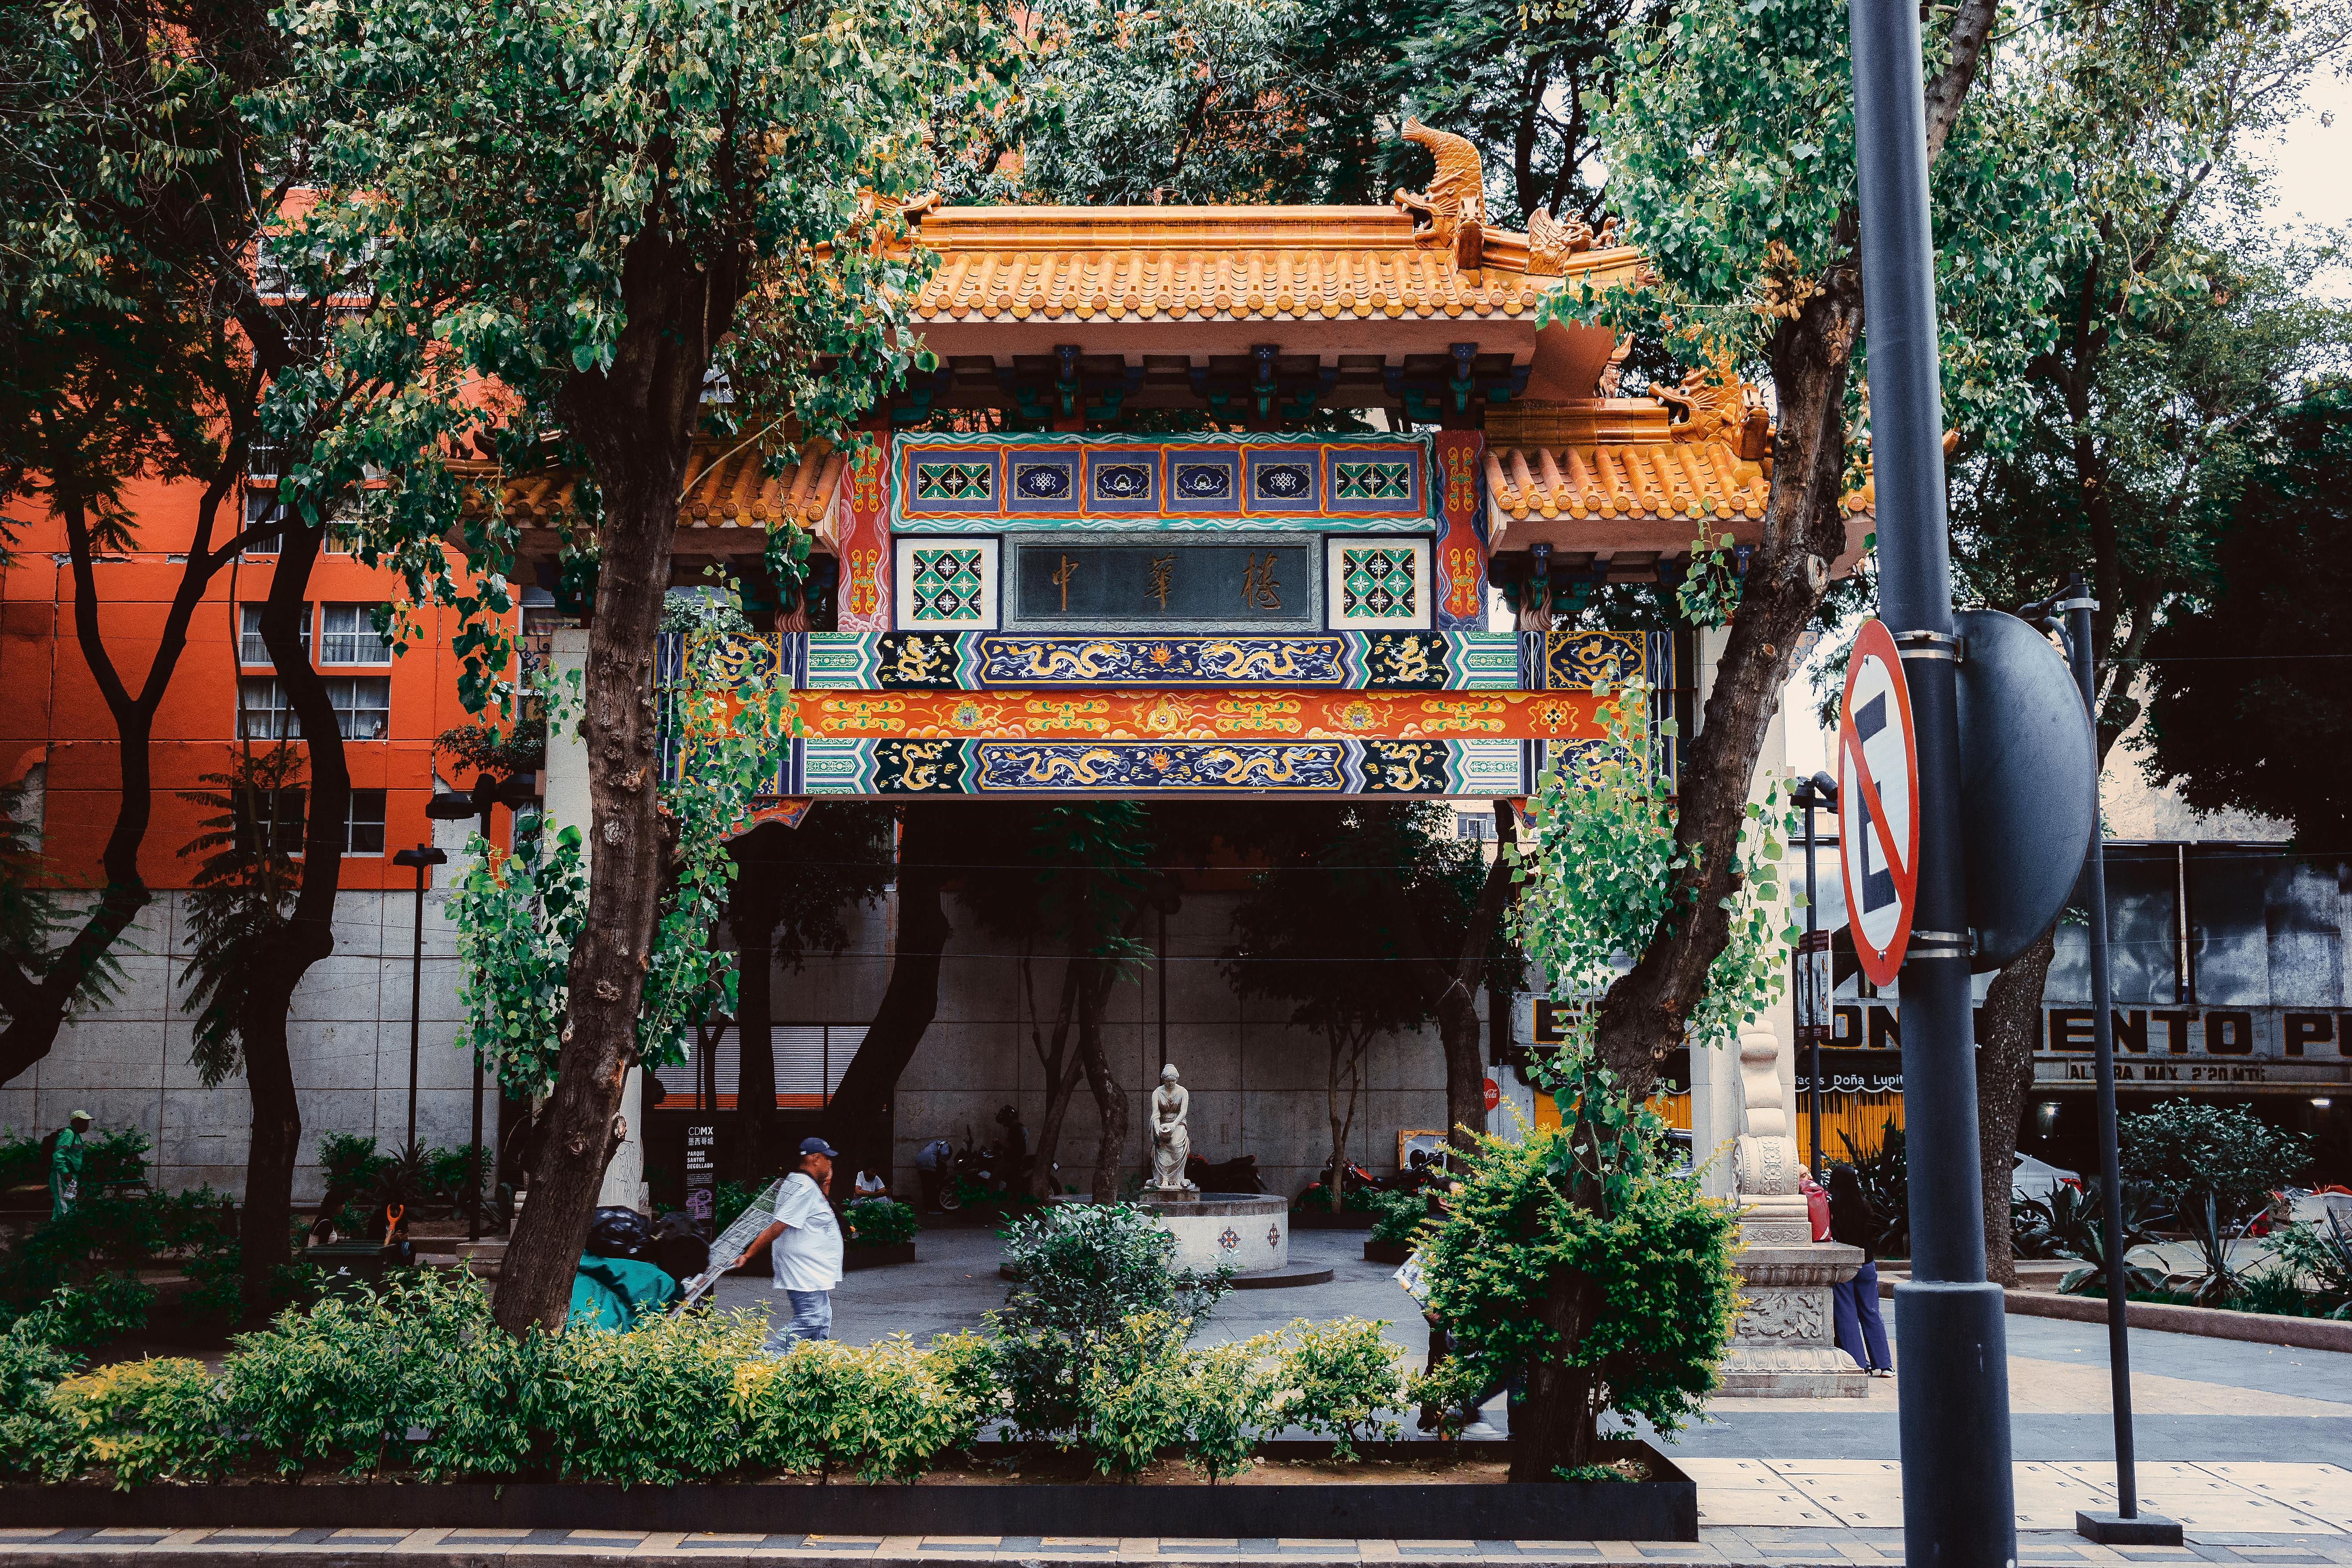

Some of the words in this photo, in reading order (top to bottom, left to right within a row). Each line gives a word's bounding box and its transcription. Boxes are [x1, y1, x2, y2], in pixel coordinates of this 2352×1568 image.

[2283, 1013, 2352, 1058] P
[2070, 1064, 2134, 1080] ALRA
[1794, 1076, 1825, 1085] Tacs
[1834, 1074, 1864, 1085] Doña
[1873, 1074, 1903, 1086] Lupit
[688, 1127, 714, 1135] CDMX
[688, 1136, 714, 1146] 墨西哥城
